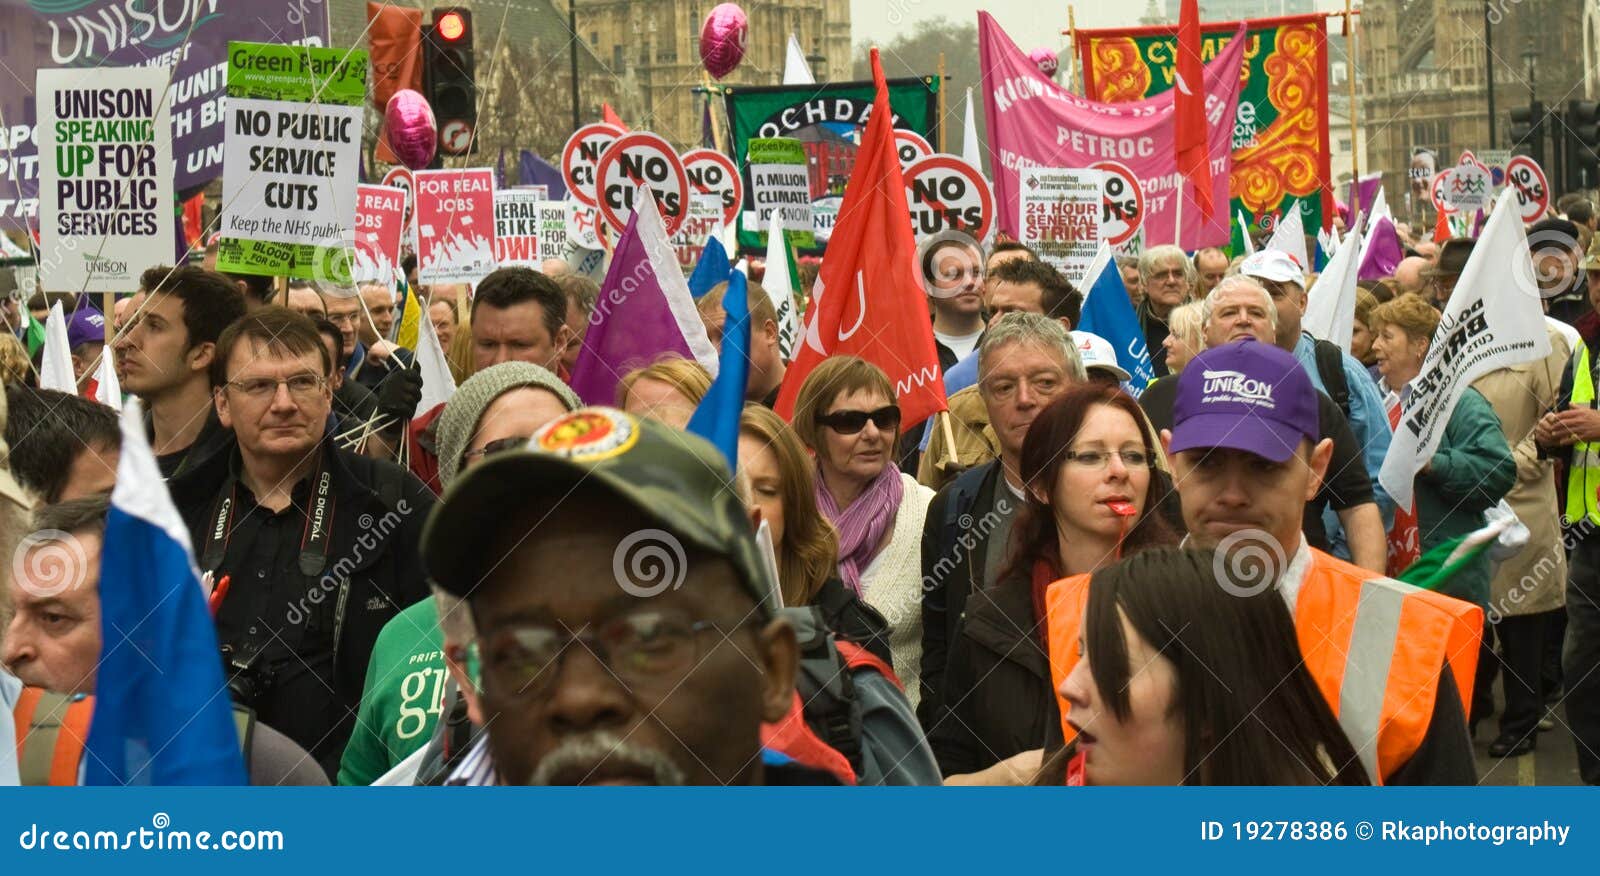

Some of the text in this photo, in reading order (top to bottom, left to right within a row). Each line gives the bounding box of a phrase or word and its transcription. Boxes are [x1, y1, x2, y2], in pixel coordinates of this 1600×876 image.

[233, 49, 293, 73] Green
[300, 52, 350, 82] Party
[55, 88, 152, 119] UNISON
[55, 119, 155, 143] SPEAKING
[235, 109, 271, 137] NO
[277, 112, 352, 143] PUBLIC
[1056, 124, 1154, 158] PETROC
[56, 144, 95, 178] UP
[99, 144, 157, 177] FOR
[250, 146, 337, 177] SERVICE
[620, 154, 669, 182] NO
[686, 165, 723, 186] NO
[756, 174, 807, 187] A MILLION
[1509, 168, 1531, 188] NO
[57, 179, 158, 211] PUBLIC
[265, 181, 319, 211] CUTS
[419, 180, 450, 195] FOR
[453, 179, 490, 193] REAL
[757, 190, 809, 205] CLIMATE
[913, 176, 966, 204] NO
[364, 195, 401, 212] REAL
[435, 198, 475, 213] JOBS
[1026, 203, 1098, 215] 24 HOUR
[57, 212, 158, 236] SERVICES
[355, 214, 383, 228] OBS
[760, 208, 786, 221] JOS
[1026, 215, 1098, 226] GENERAL
[230, 215, 259, 235] Keep
[262, 217, 282, 233] the
[284, 220, 311, 237] NHS
[496, 220, 537, 236] RIKE
[1026, 226, 1099, 240] STRIKE
[545, 231, 567, 244] FOR
[251, 253, 268, 265] FOR
[253, 241, 291, 261] BLOOD
[86, 261, 128, 274] UNISON
[1203, 376, 1273, 399] UNISON
[310, 471, 330, 542] EOS DIGITAL
[214, 498, 232, 541] Canon
